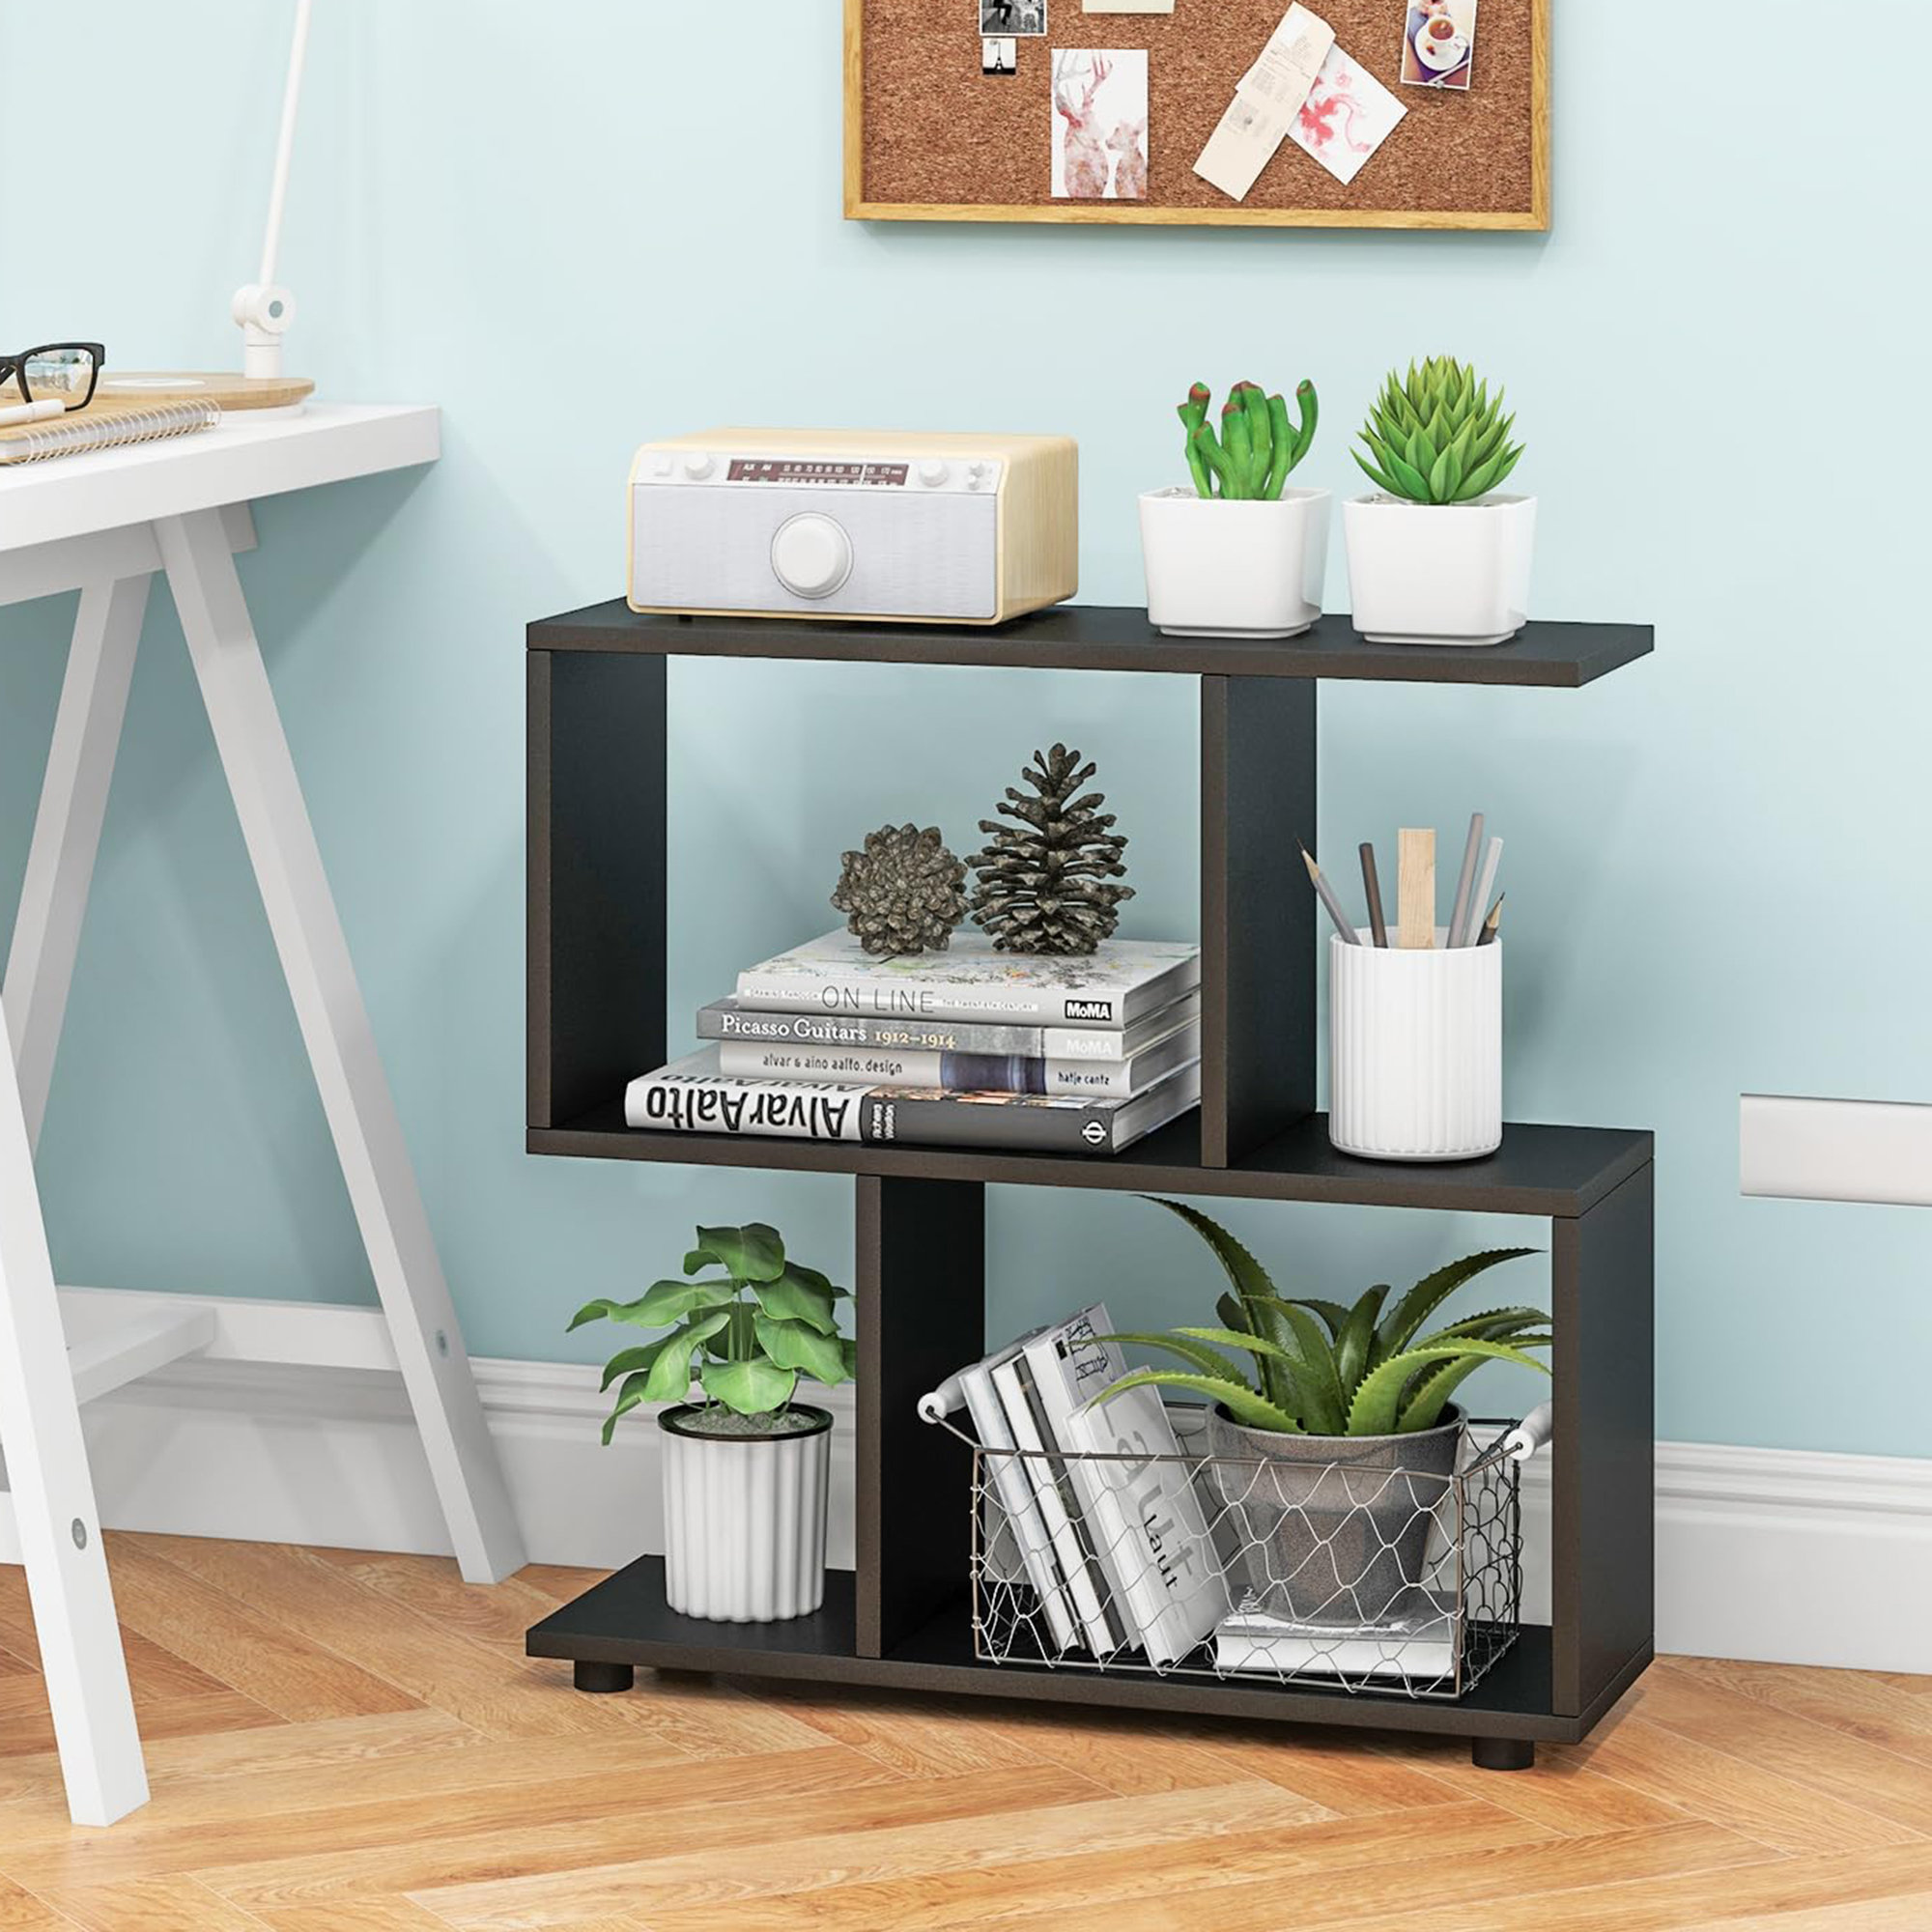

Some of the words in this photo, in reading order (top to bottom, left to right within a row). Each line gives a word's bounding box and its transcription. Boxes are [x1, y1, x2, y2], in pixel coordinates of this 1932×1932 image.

[822, 985, 860, 1009] ON
[874, 988, 934, 1013] LINE
[1066, 1002, 1110, 1019] MoMA
[722, 1014, 790, 1037] Picasso
[794, 1018, 867, 1042] Guitars
[1066, 1039, 1113, 1056] MoMA
[762, 1053, 791, 1067] alvar
[804, 1055, 829, 1070] aino
[1143, 1513, 1178, 1588] Laut
